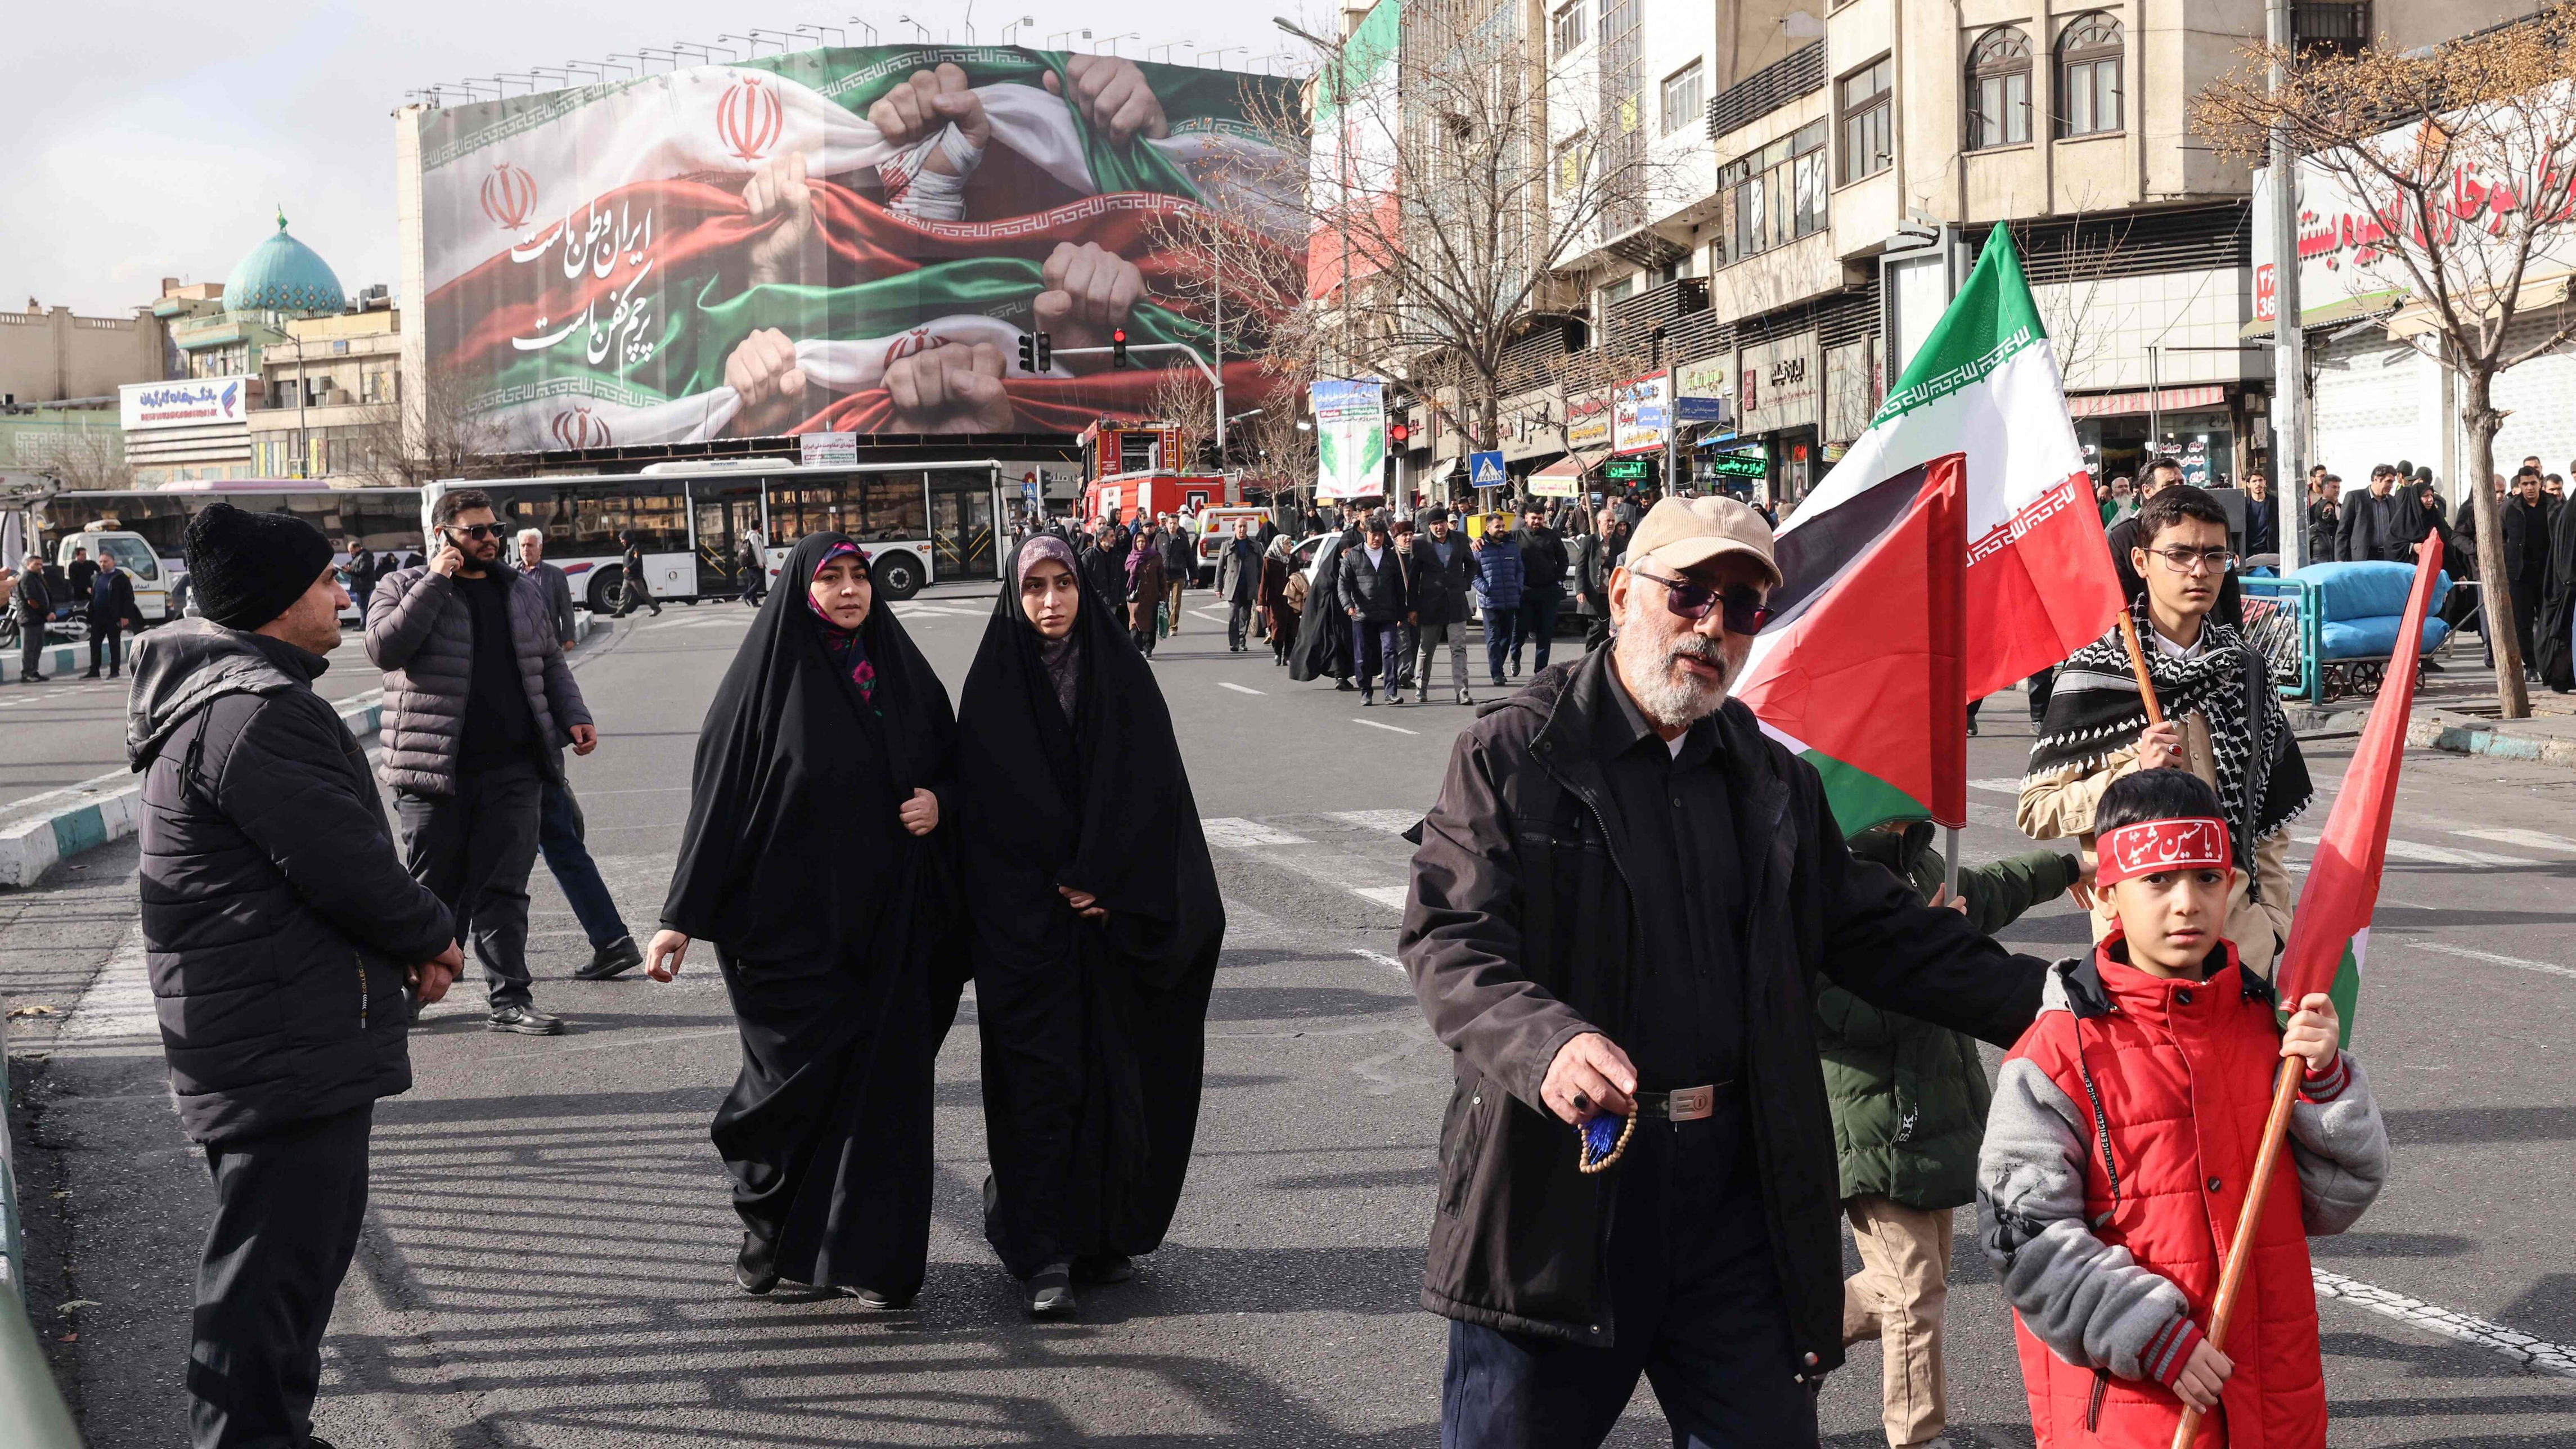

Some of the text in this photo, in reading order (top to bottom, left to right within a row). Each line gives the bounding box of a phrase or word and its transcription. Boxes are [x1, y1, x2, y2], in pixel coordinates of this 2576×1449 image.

[564, 197, 612, 279] وطن
[594, 200, 651, 279] ایران
[587, 258, 653, 365] کفن
[2259, 296, 2276, 316] 36
[619, 297, 653, 388] پرچم
[1772, 358, 1804, 387] ایران فیلم
[2188, 441, 2204, 452] انواع
[1610, 463, 1642, 476] آیفون
[1718, 458, 1763, 474] لوازم جانبی
[2159, 823, 2203, 862] حسین
[2204, 826, 2213, 858] یا
[1899, 1114, 1914, 1142] S.K
